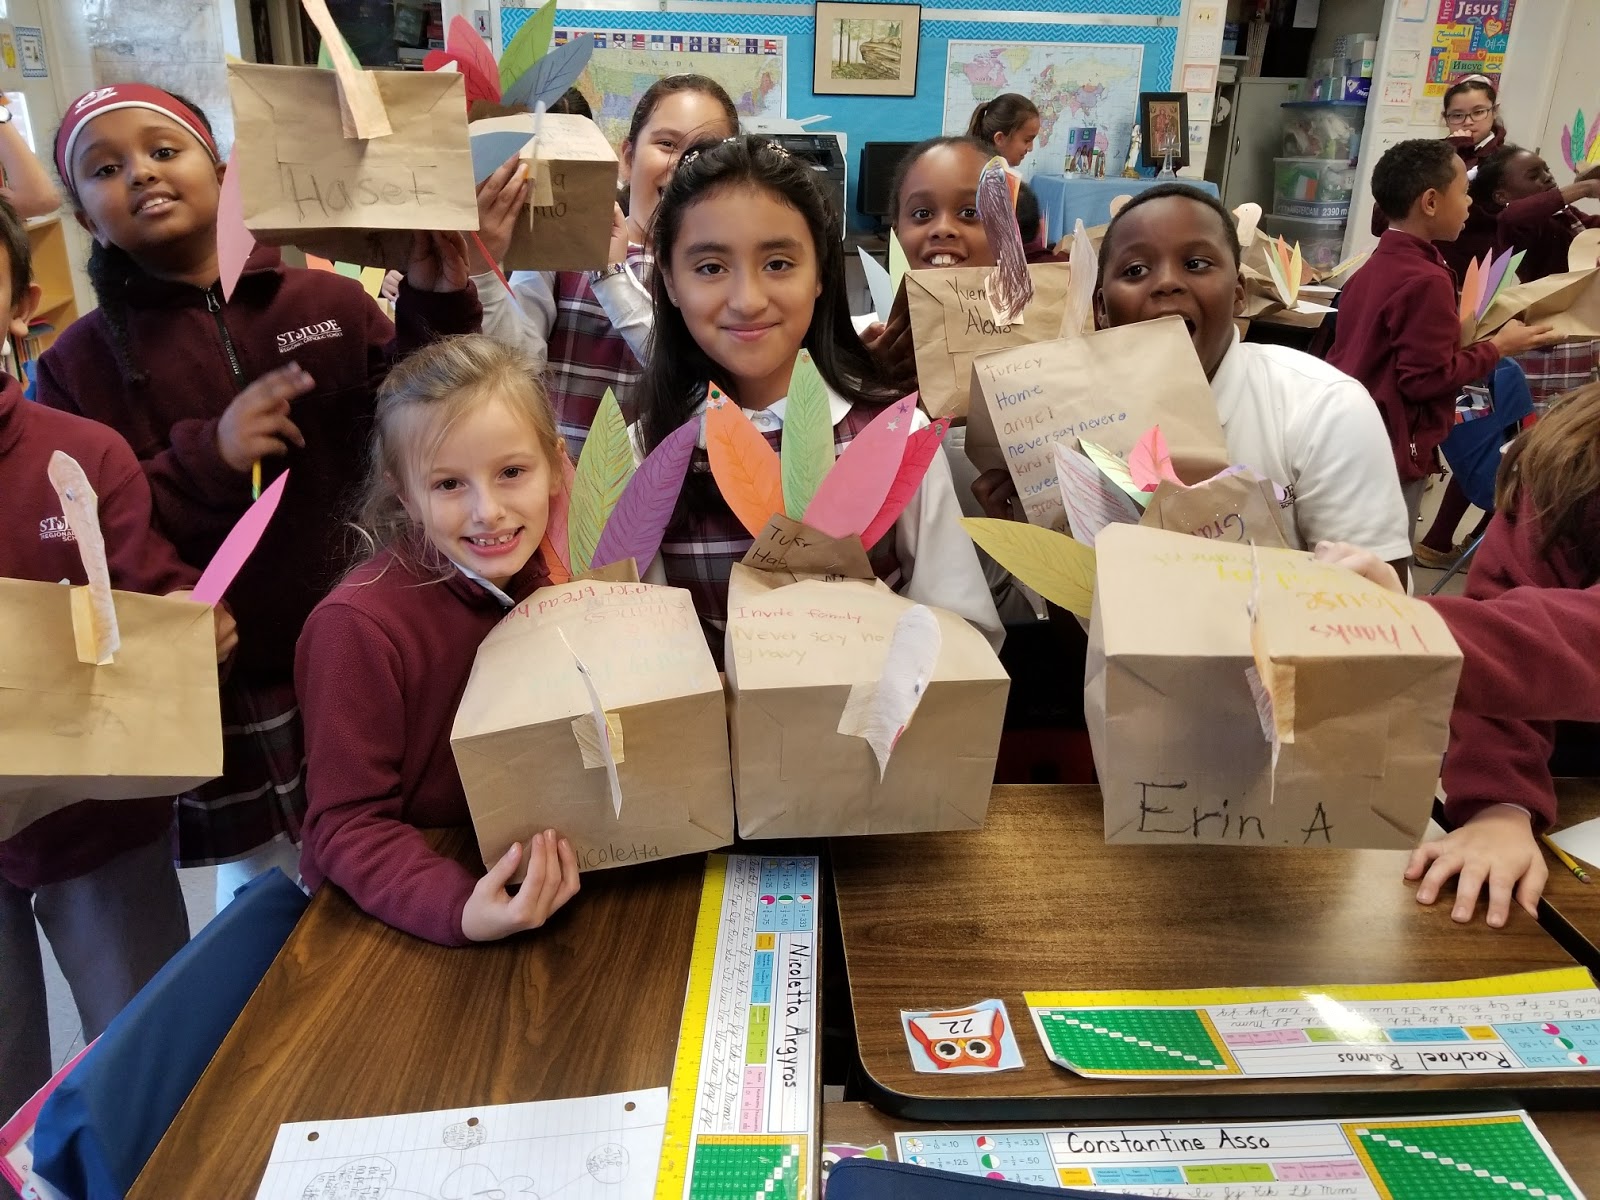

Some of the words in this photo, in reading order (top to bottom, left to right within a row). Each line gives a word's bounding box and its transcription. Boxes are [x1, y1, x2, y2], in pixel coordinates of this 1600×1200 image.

[1455, 2, 1498, 19] JESUS
[1453, 61, 1482, 71] Иисус
[288, 167, 436, 223] Haset
[1322, 208, 1340, 217] 2390
[995, 384, 1044, 410] Home
[1024, 476, 1060, 496] swee
[735, 606, 793, 619] Invite
[786, 943, 811, 1018] Nicoletta
[939, 1018, 974, 1035] 22
[776, 1024, 809, 1088] Argyros
[1337, 1053, 1403, 1070] Ramos
[1067, 1129, 1206, 1154] Constantine
[1218, 1128, 1270, 1149] Asso
